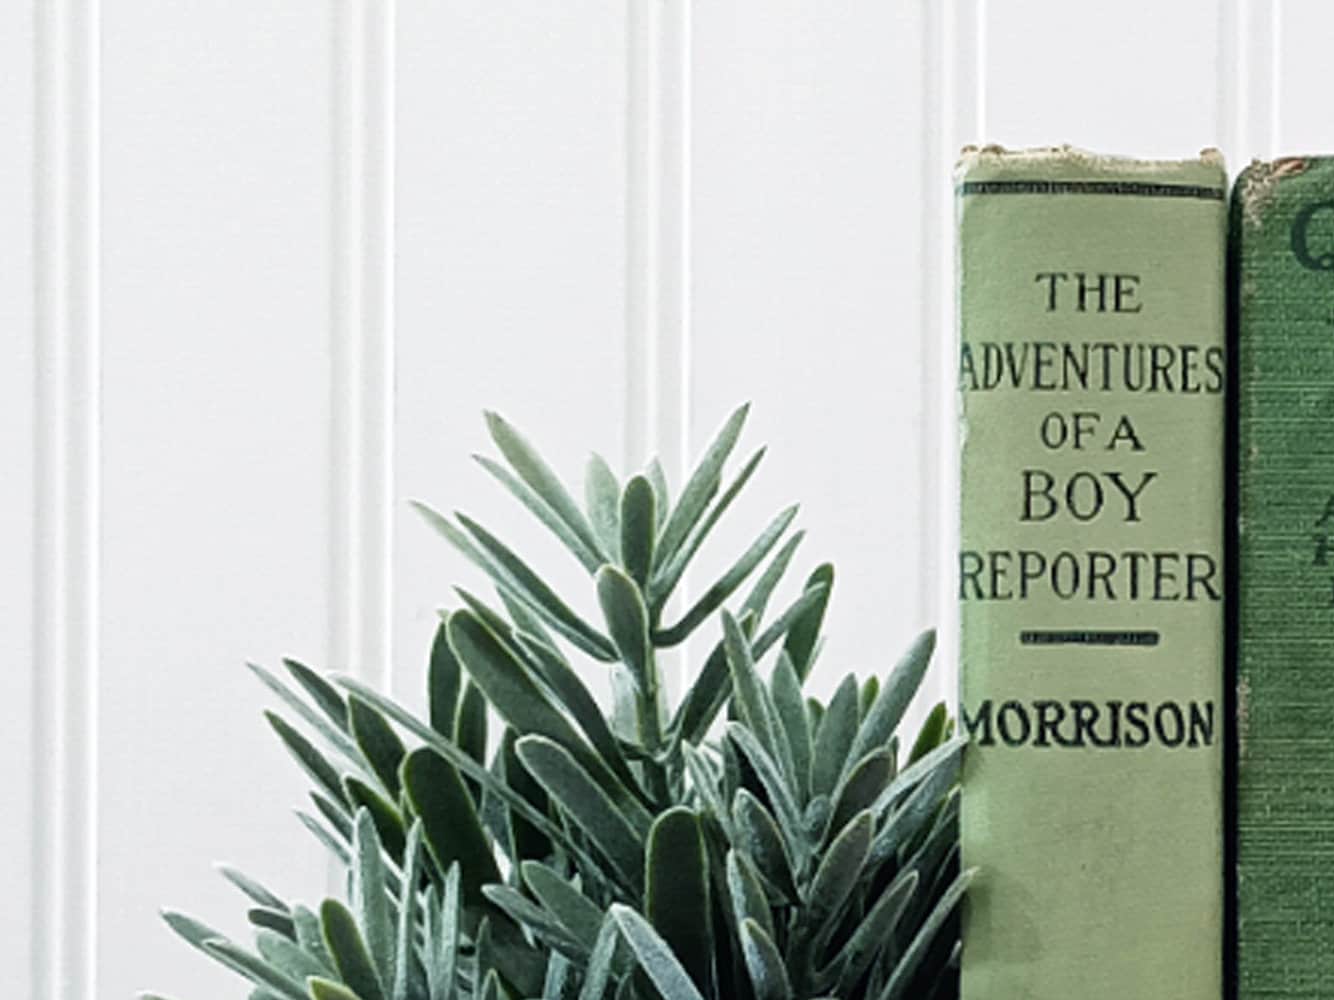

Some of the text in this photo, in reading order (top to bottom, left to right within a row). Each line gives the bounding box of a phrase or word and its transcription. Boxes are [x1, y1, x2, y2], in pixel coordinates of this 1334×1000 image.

[1036, 273, 1143, 314] THE
[957, 341, 1224, 394] ADVENTURES
[1021, 471, 1158, 522] BOY
[959, 551, 1221, 601] REPORTER
[962, 700, 1215, 747] MORRISON
